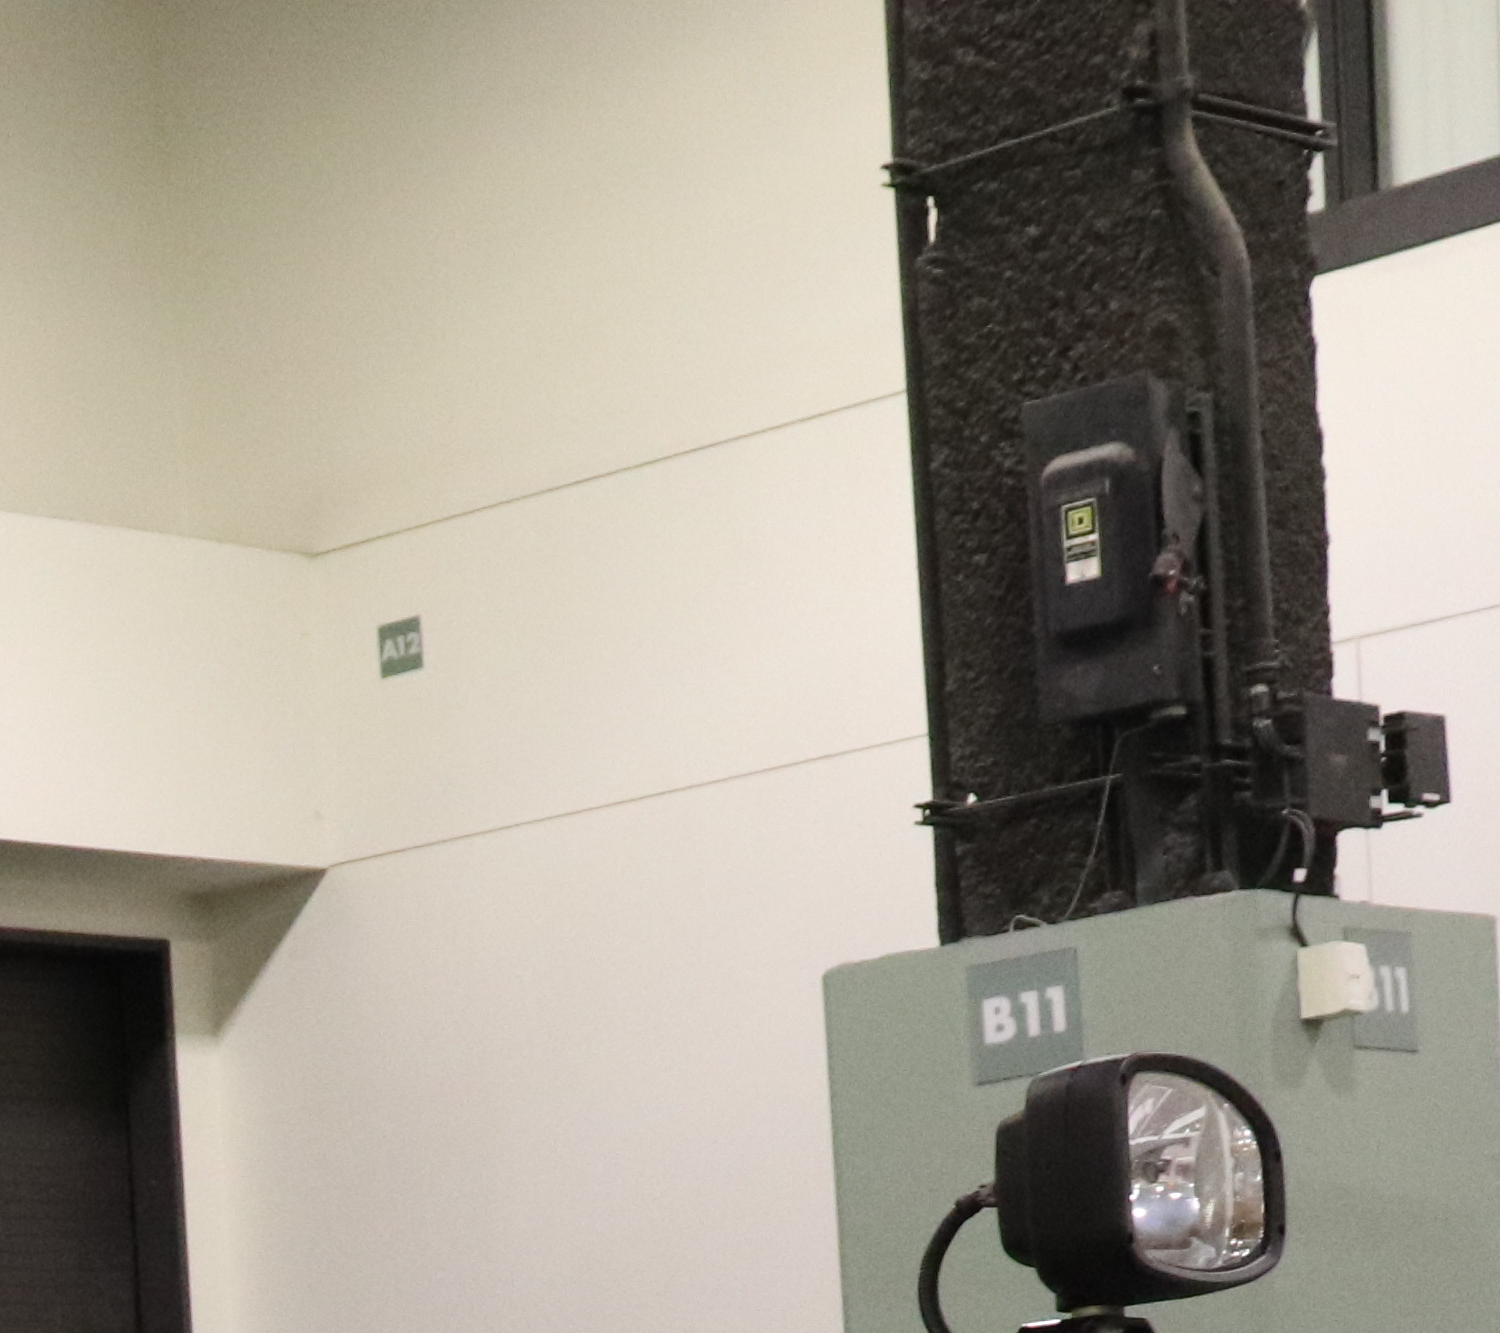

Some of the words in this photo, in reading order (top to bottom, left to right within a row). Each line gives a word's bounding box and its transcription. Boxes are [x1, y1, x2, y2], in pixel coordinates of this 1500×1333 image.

[382, 631, 422, 661] A12
[1369, 964, 1410, 1014] 11
[981, 985, 1067, 1045] B11
